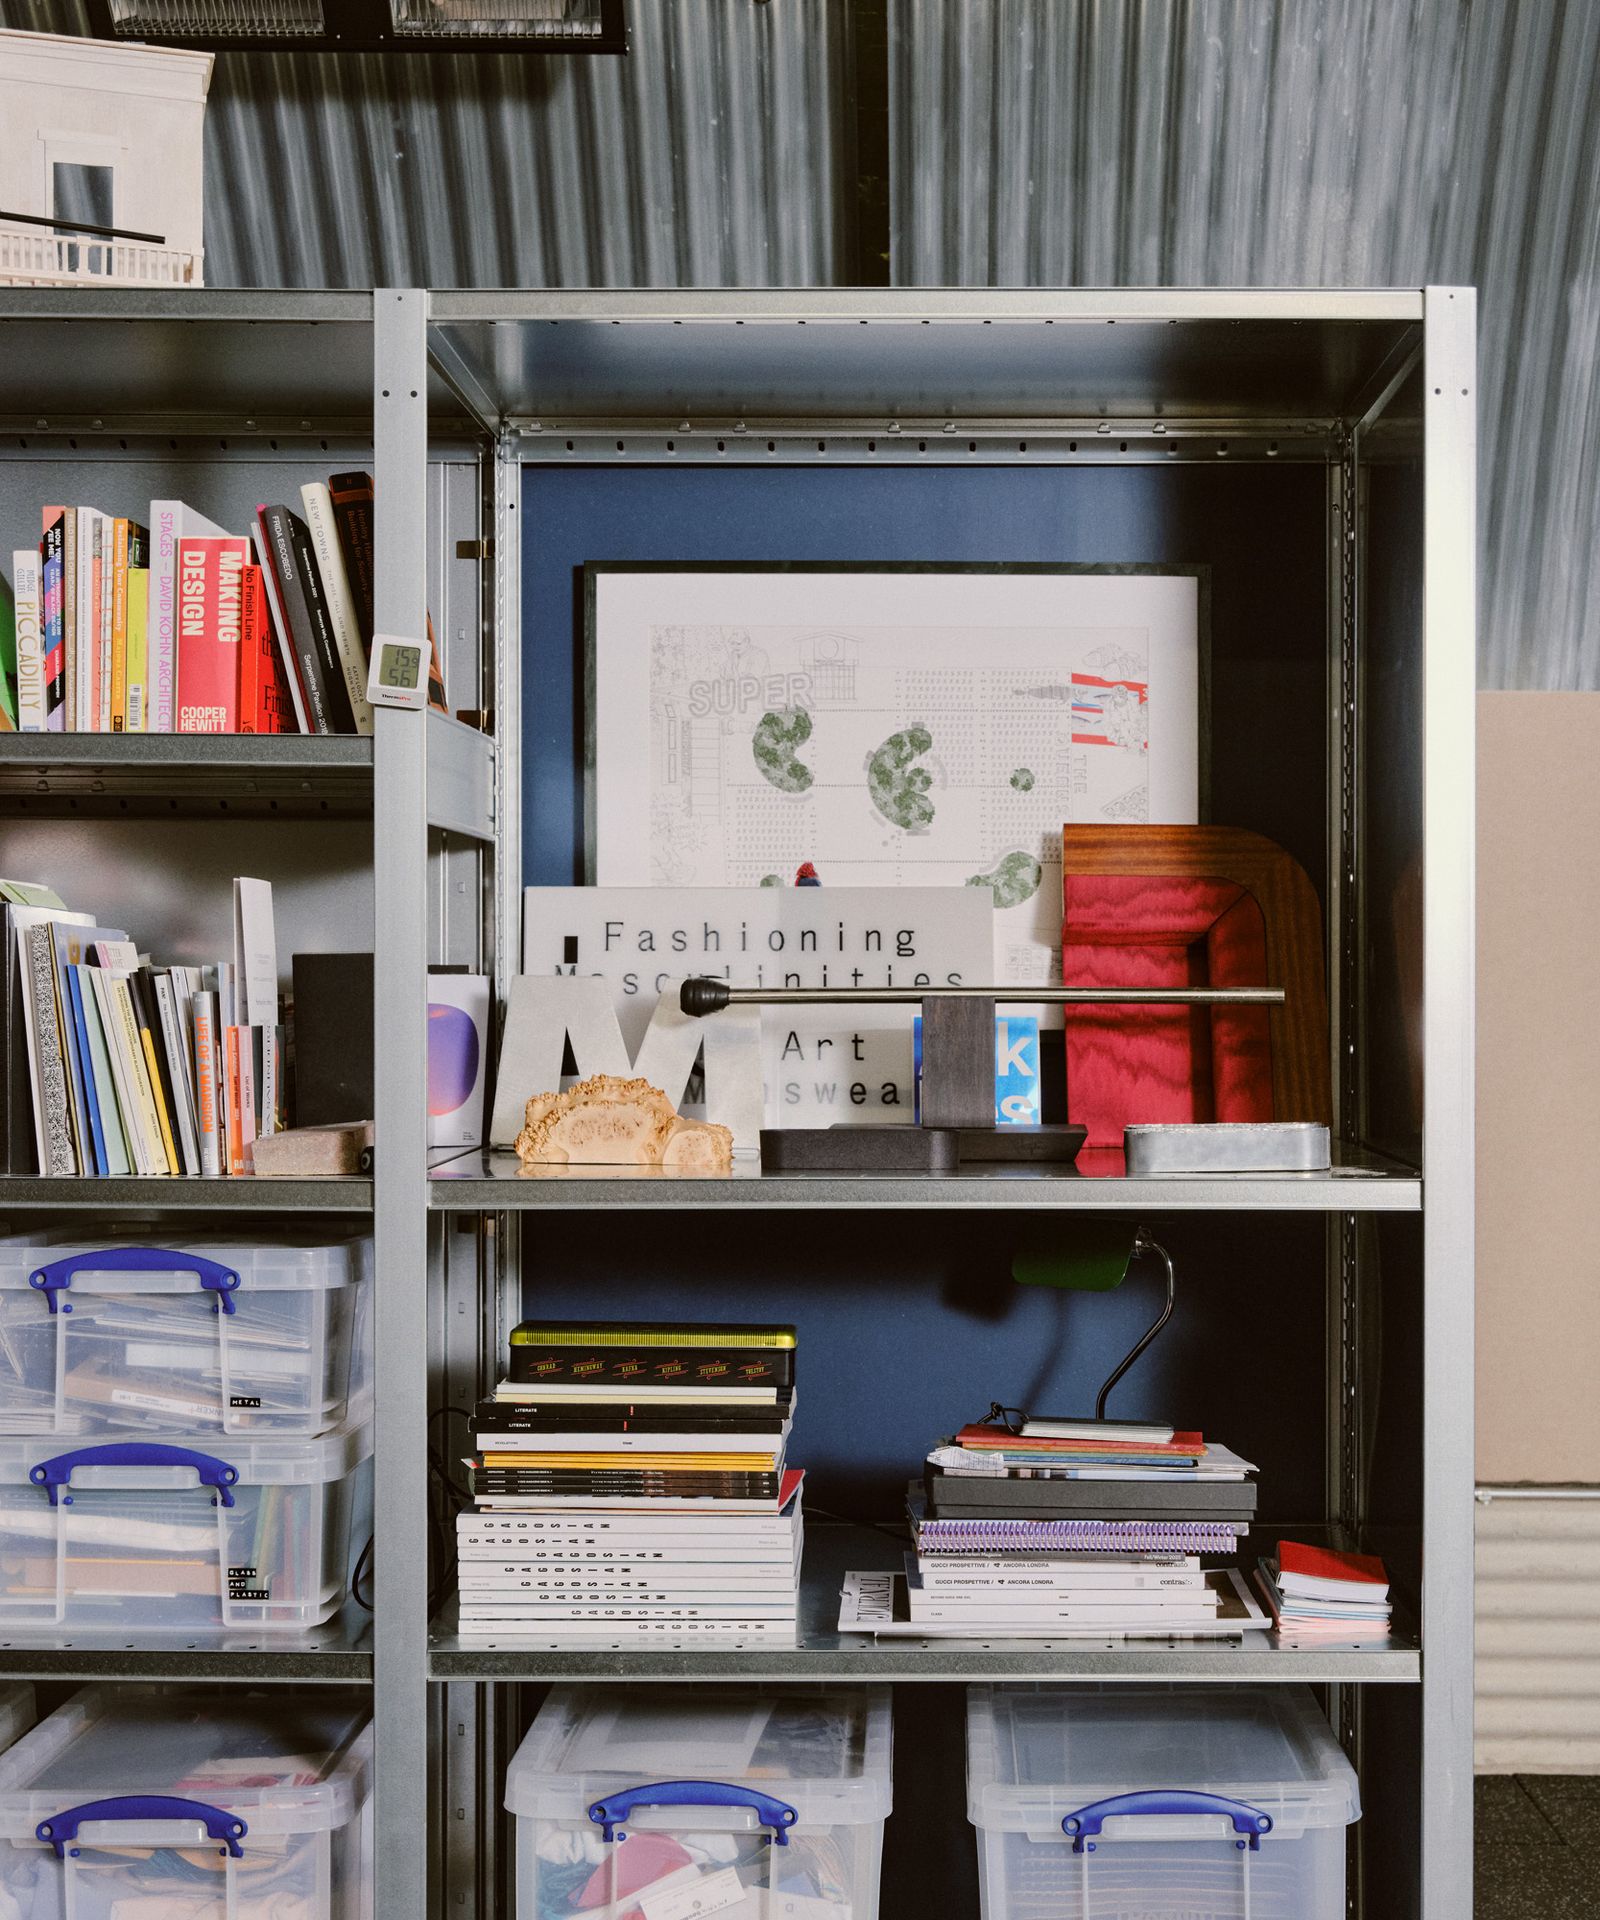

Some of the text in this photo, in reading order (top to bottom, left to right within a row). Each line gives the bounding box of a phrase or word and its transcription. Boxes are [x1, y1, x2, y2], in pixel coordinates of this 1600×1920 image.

[160, 511, 173, 557] STAGES
[271, 515, 283, 538] FRIDA
[278, 538, 293, 580] ESCOBEDO
[308, 497, 330, 561] NEW TOWNS
[16, 568, 26, 594] GILLIES
[26, 569, 36, 593] MIDGE
[114, 524, 125, 632] Reclaiming Your Community
[160, 575, 172, 612] DAVID
[182, 551, 206, 636] DESIGN
[217, 551, 242, 643] MAKING
[244, 568, 254, 641] No Finish Line
[17, 601, 41, 710] PICCADILLY
[160, 616, 172, 656] KOHN
[158, 659, 172, 733] ARCHITECTS
[303, 653, 318, 691] Serpentine
[311, 691, 324, 718] Pavilion
[388, 668, 411, 687] 56
[688, 672, 816, 718] SUPER
[181, 706, 227, 719] COOPER
[181, 719, 227, 731] HEWITT
[603, 921, 917, 957] Fashioning
[780, 1030, 865, 1061] Art
[196, 1016, 214, 1133] LIFE OF A MANSION
